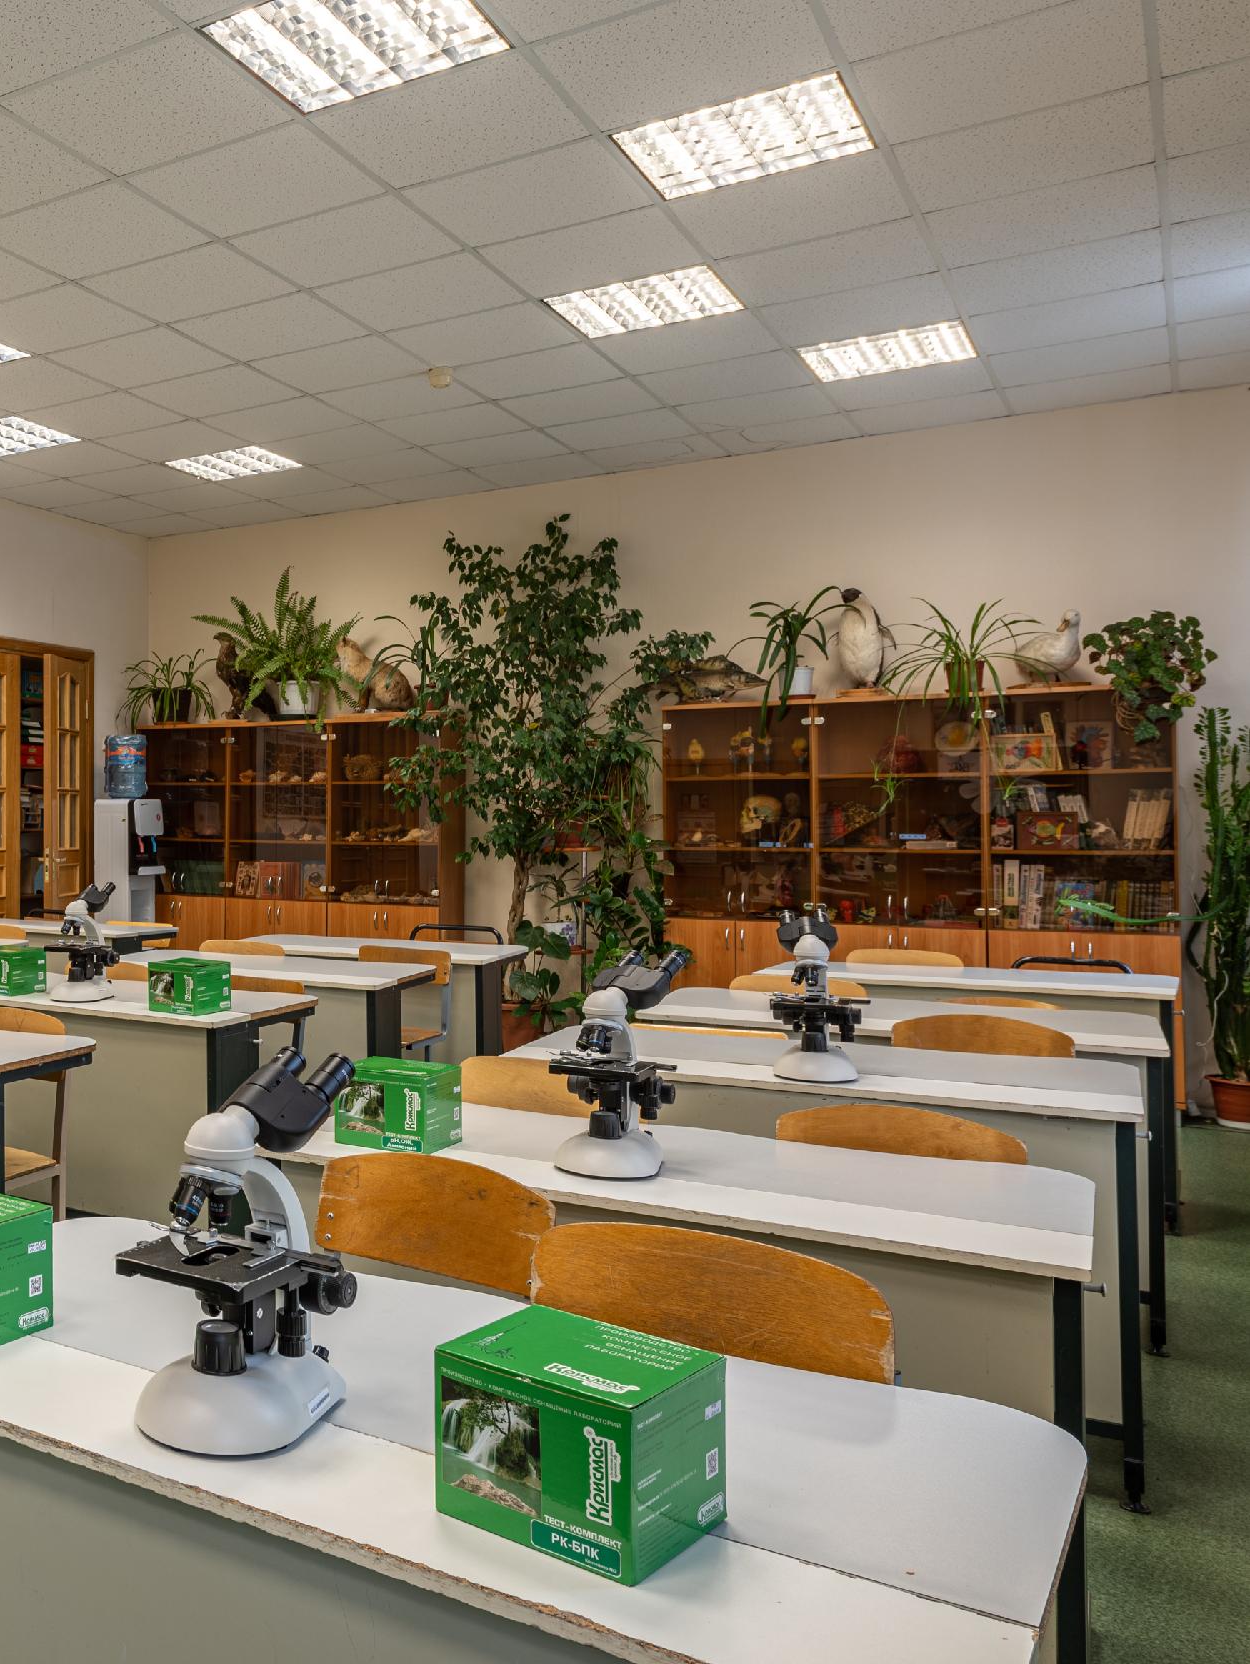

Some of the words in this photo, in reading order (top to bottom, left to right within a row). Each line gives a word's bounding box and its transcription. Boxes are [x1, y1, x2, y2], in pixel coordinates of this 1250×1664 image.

[584, 1344, 676, 1371] ЛАБОРАТОРИЙ
[601, 1334, 693, 1361] КОМПЛЕКСНОЕ
[605, 1342, 685, 1366] ОСНАЩЕНИЕ
[547, 1362, 631, 1392] Крисмас
[573, 1410, 622, 1429] ЛАБОРАТОРИЙ
[588, 1437, 610, 1524] Крисмас
[543, 1514, 622, 1549] ТЕСТ-КОМПЛЕКТ
[551, 1532, 600, 1561] РК-БПК
